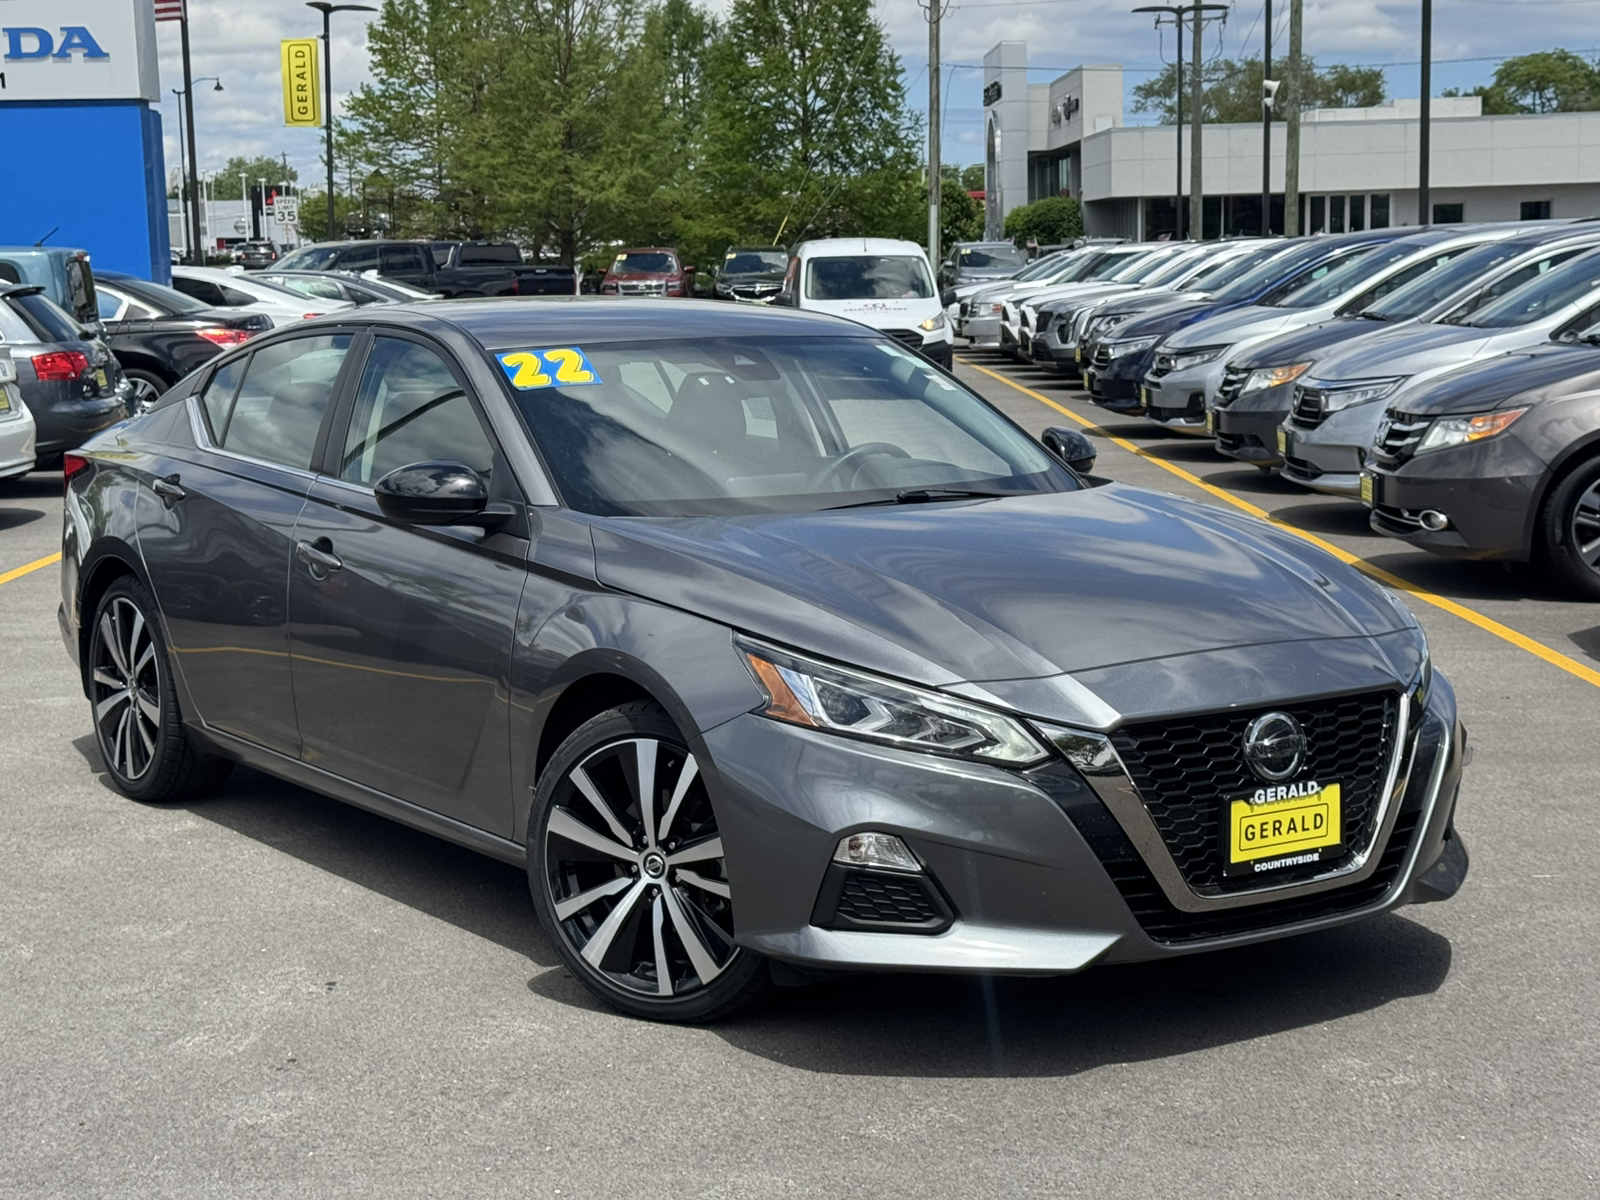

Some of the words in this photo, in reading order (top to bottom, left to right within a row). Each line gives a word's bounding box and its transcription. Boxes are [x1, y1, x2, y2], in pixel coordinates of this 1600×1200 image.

[294, 50, 309, 115] GERALD
[277, 211, 296, 222] 35
[502, 349, 595, 387] 22
[1254, 738, 1299, 755] NISSAN
[1254, 781, 1318, 804] GERALD
[1244, 813, 1324, 842] GERALD
[1254, 853, 1320, 872] COUNTRYSIDE
